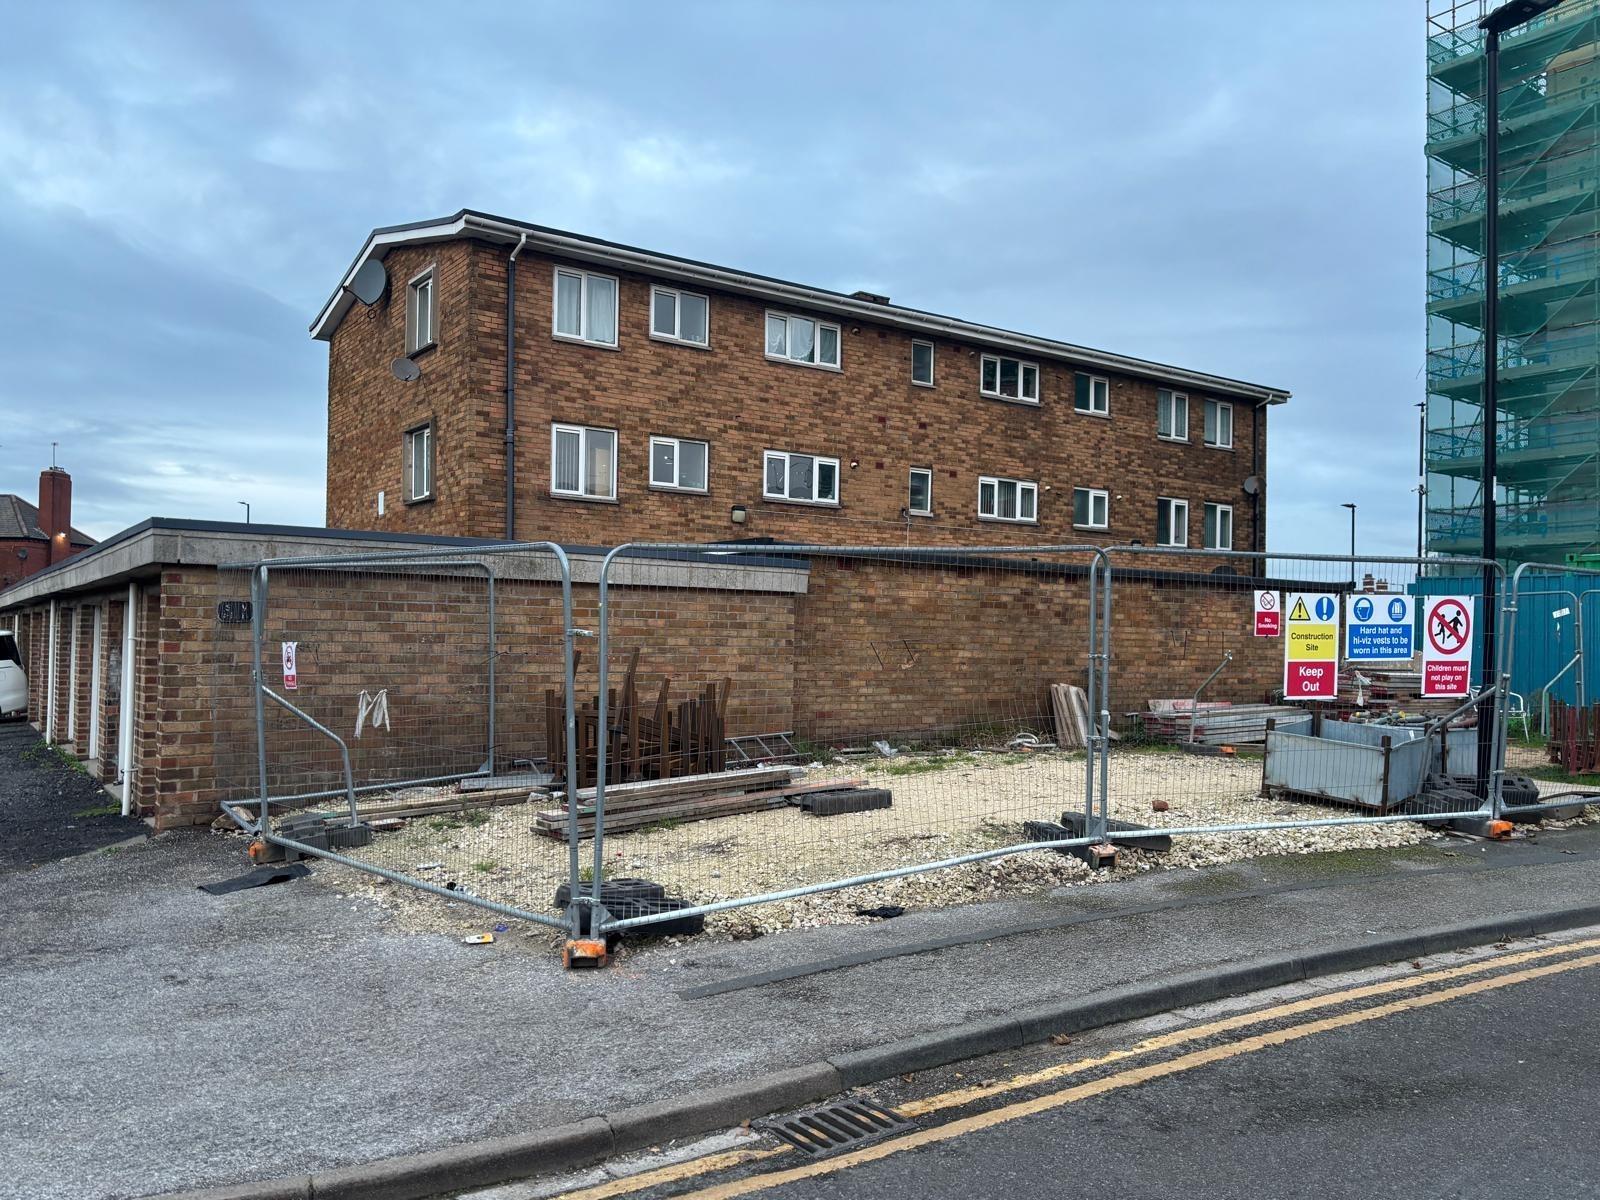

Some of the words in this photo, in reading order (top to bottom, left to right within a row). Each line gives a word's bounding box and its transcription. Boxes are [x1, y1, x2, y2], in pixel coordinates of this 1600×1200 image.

[1258, 622, 1277, 630] Smoking
[1360, 626, 1377, 634] Hard
[1378, 626, 1389, 634] hat
[1390, 626, 1403, 634] and
[1291, 632, 1334, 640] Construction
[1353, 636, 1371, 645] hi-viz
[1400, 636, 1408, 644] be
[1305, 643, 1319, 651] Site
[1299, 666, 1324, 678] Keep
[1441, 674, 1454, 682] play
[1302, 681, 1320, 692] Out
